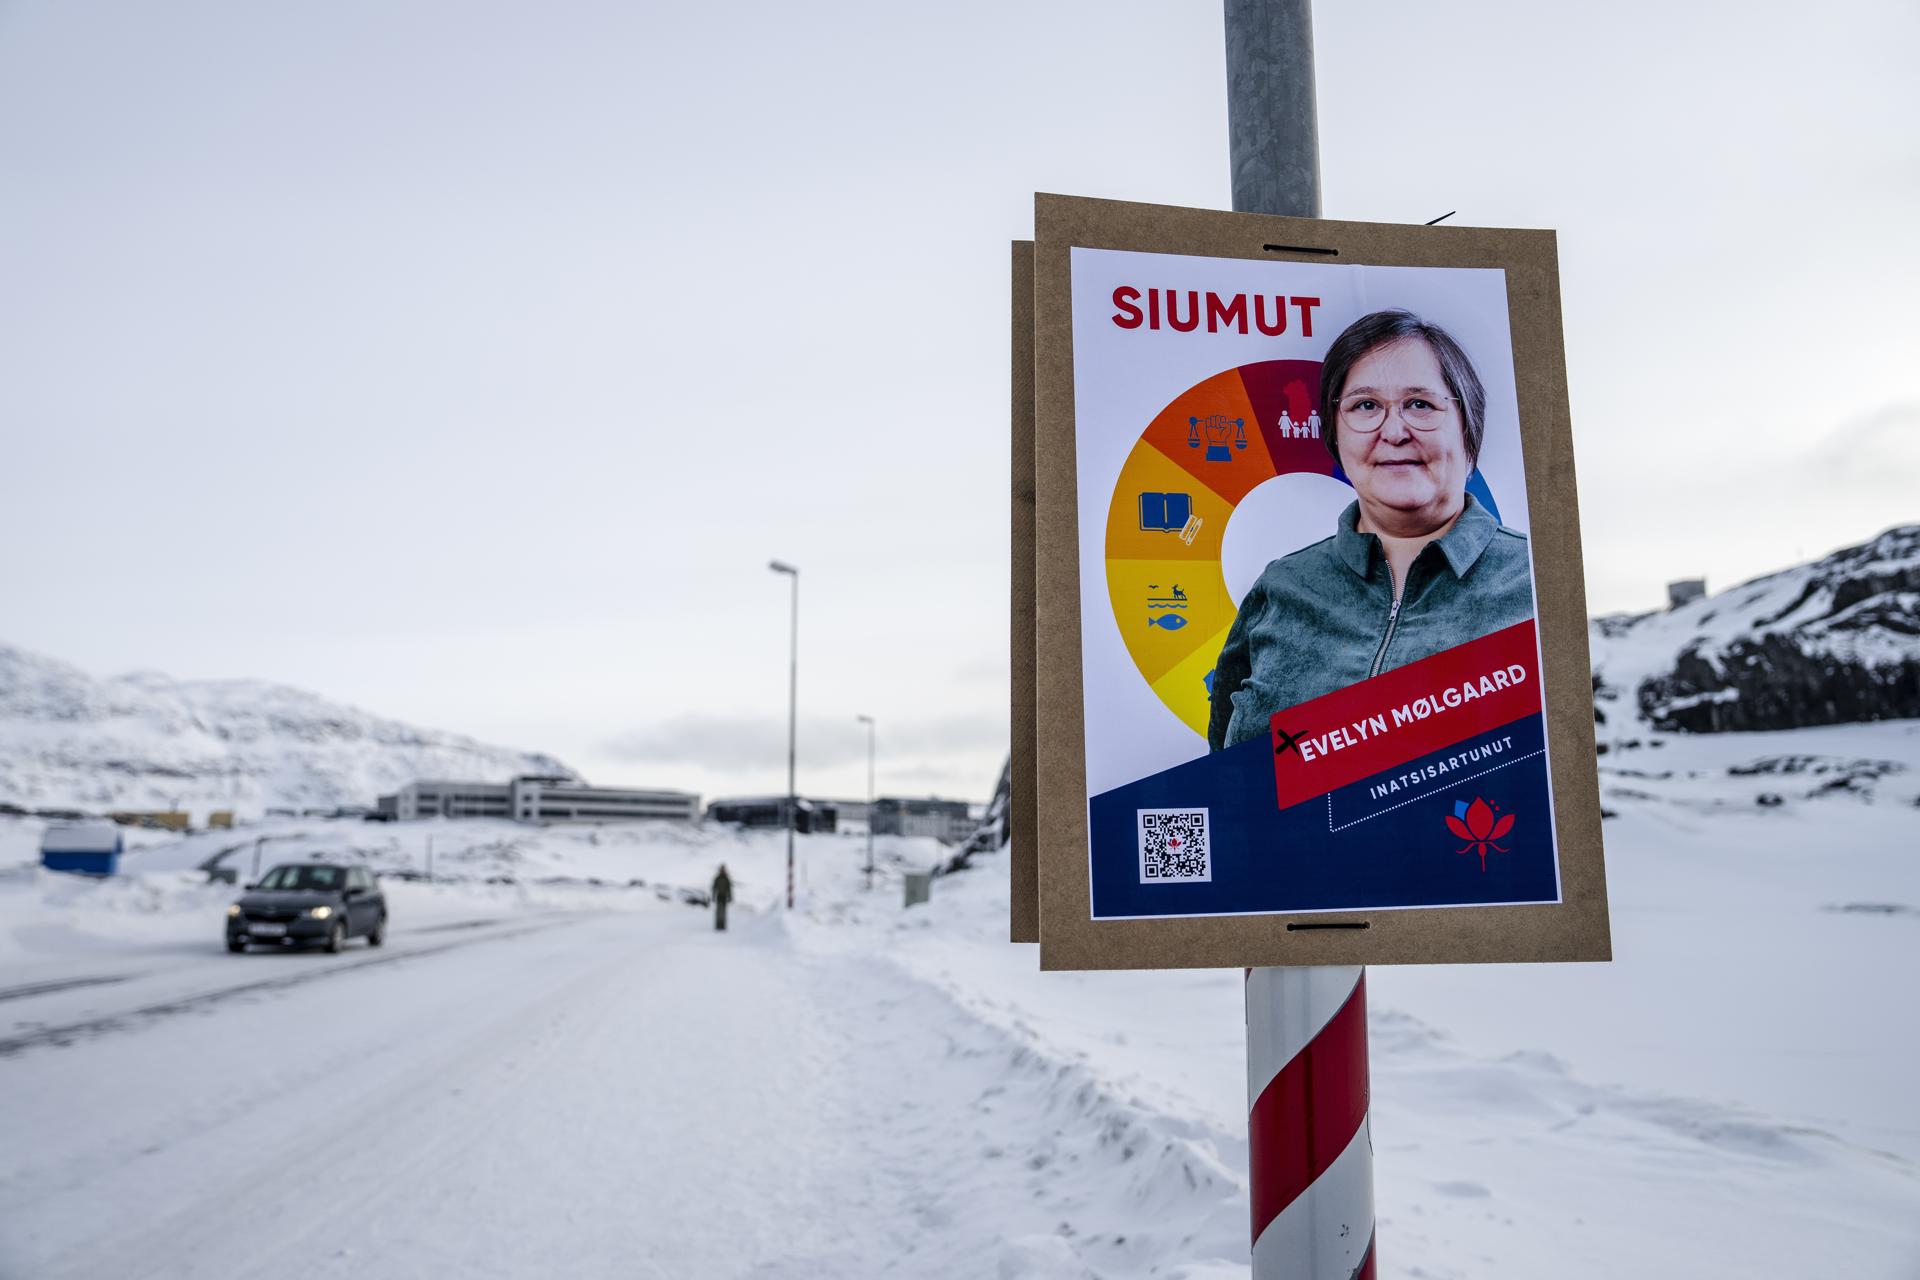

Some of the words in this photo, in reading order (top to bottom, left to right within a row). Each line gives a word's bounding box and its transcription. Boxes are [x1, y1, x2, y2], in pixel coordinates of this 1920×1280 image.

[1112, 286, 1321, 337] SIUMUT
[1299, 714, 1388, 762] EVELYN
[1391, 664, 1527, 727] MØLGAARD
[1370, 736, 1513, 800] INATSISARTUNUT
